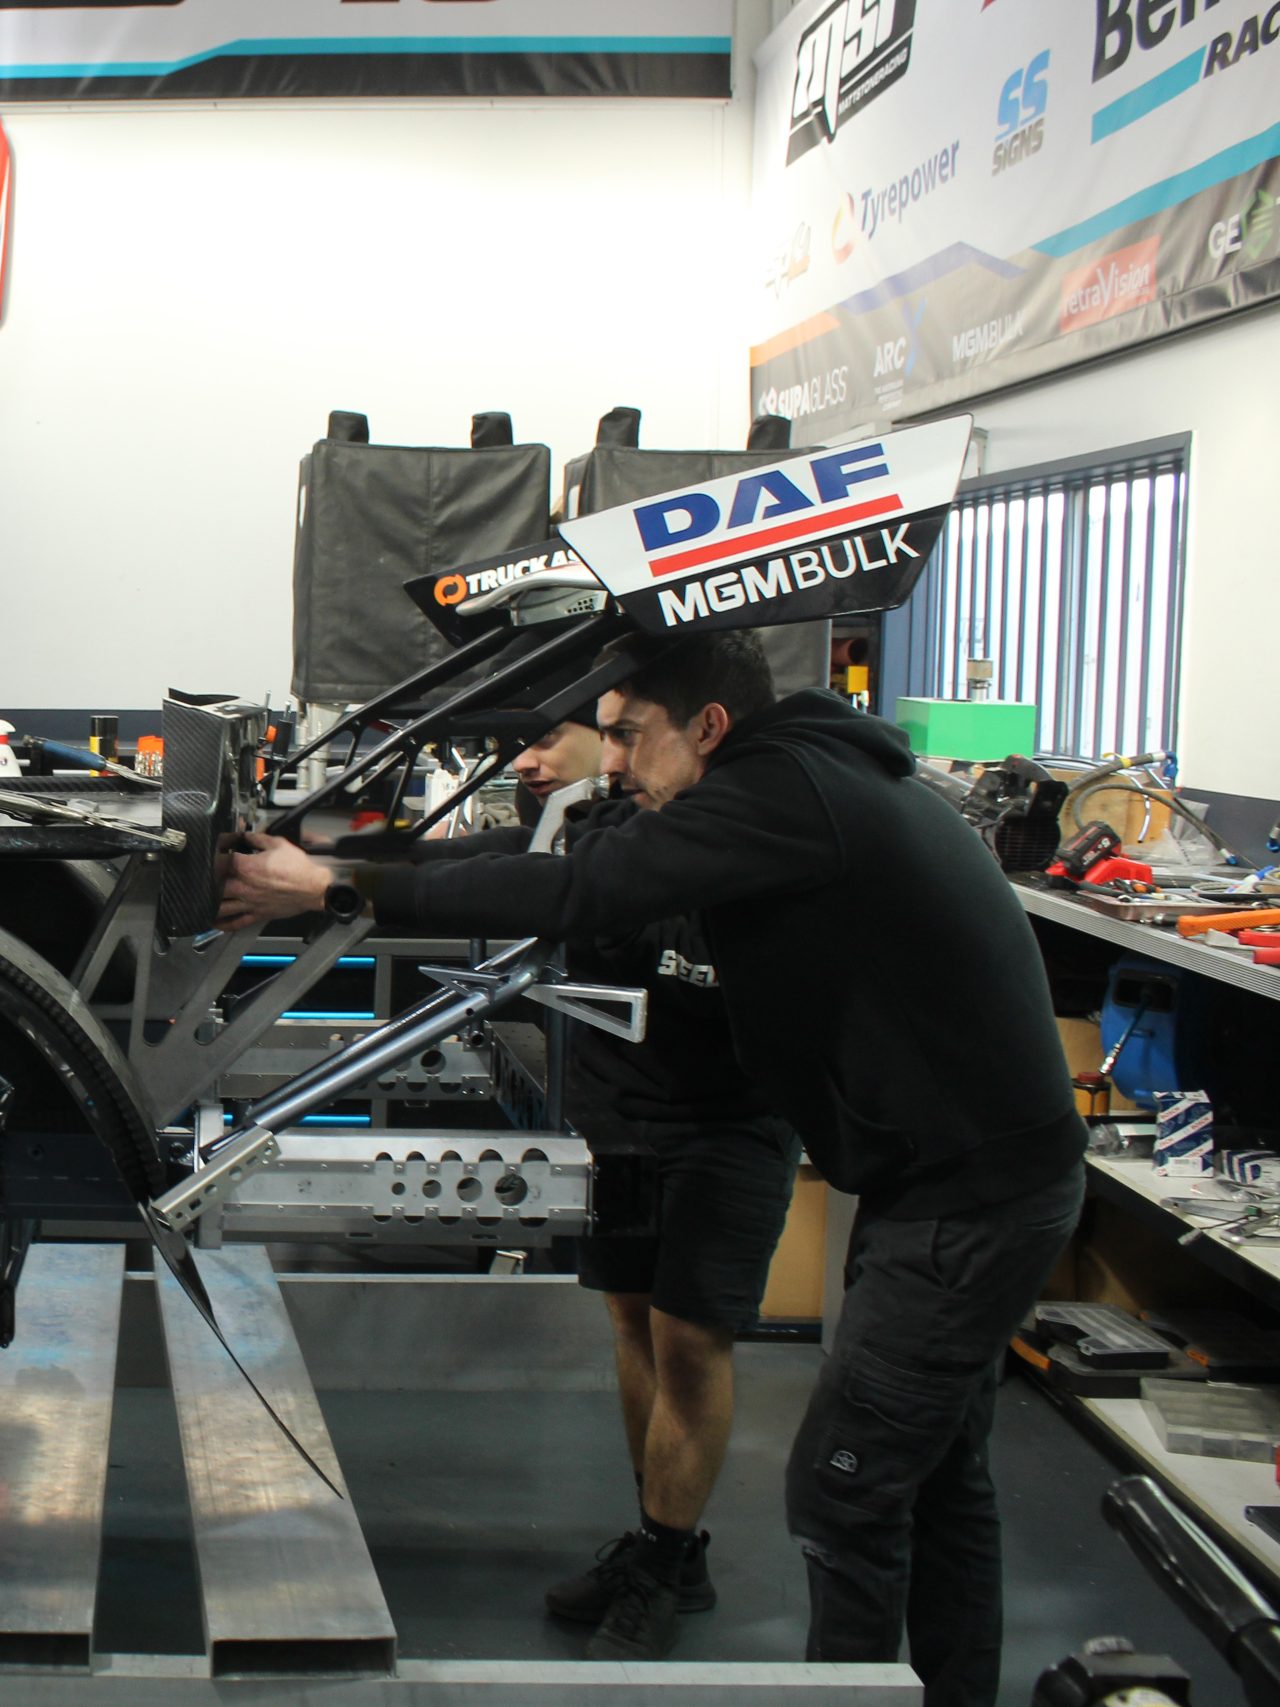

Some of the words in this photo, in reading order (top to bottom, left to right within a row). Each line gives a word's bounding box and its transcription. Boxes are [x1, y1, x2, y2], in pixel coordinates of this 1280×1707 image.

[991, 117, 1045, 178] SIGNS
[860, 140, 960, 242] Tyrepower
[873, 337, 906, 378] ARC
[633, 443, 890, 552] DAF
[466, 554, 548, 595] TRUCK
[658, 522, 920, 627] MGMBULK
